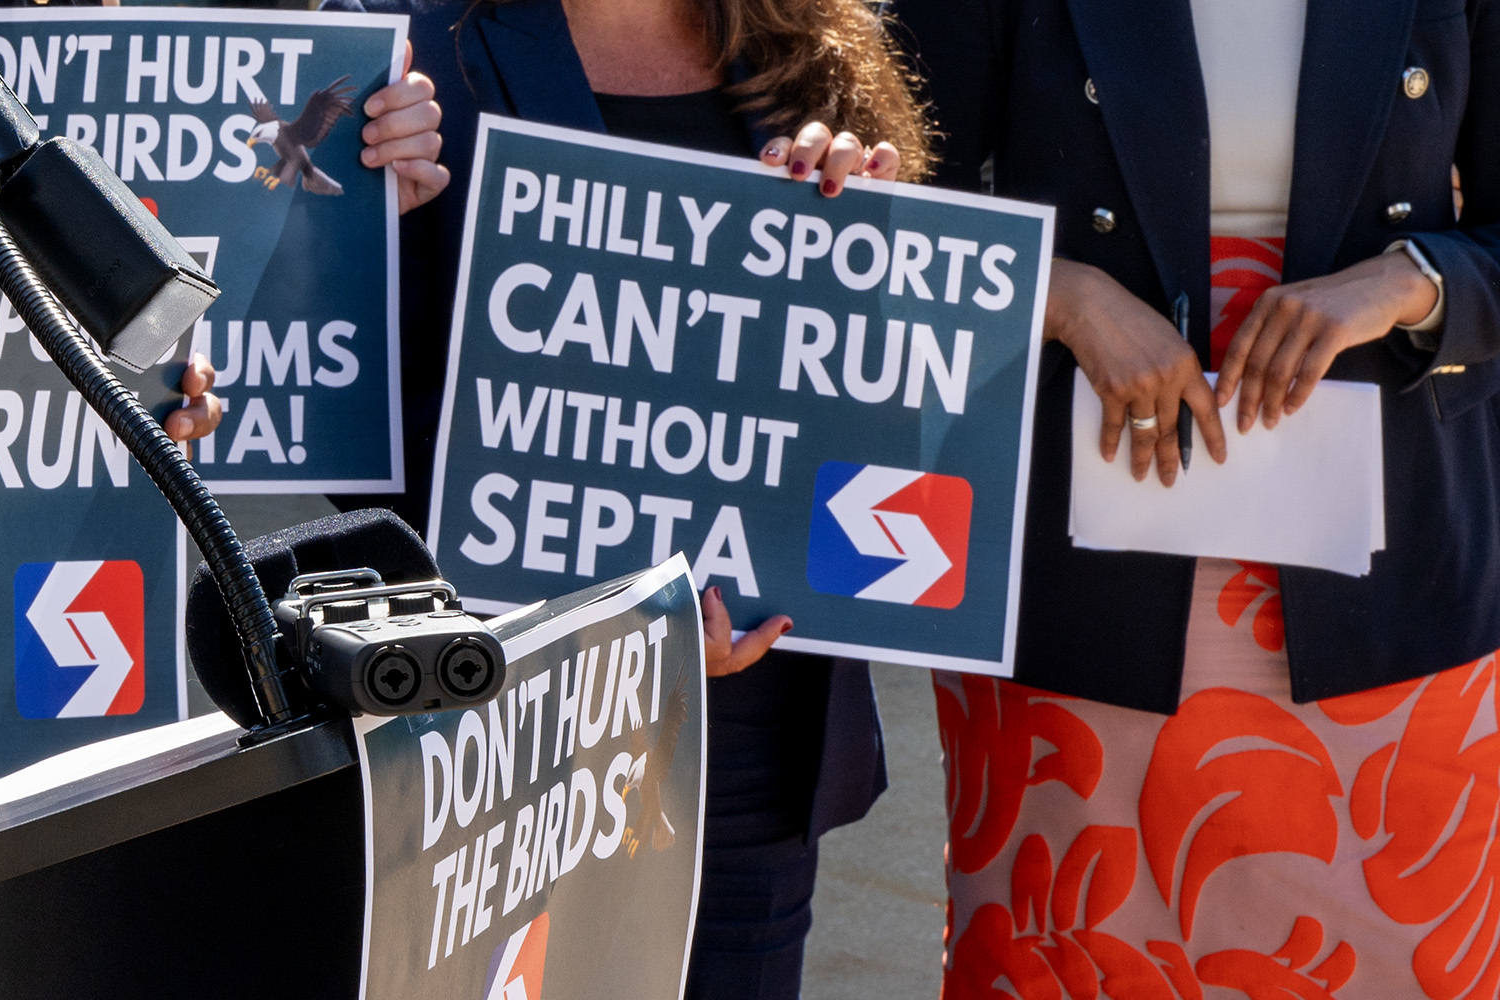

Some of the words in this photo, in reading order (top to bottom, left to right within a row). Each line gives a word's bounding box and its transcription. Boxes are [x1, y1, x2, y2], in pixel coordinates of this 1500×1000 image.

[125, 34, 313, 107] HURT
[498, 166, 731, 267] PHILLY
[740, 207, 1017, 311] SPORTS
[488, 262, 761, 383] CAN'T
[779, 305, 974, 416] RUN
[475, 377, 799, 487] WITHOUT
[459, 472, 761, 598] SEPTA
[419, 668, 551, 852] DON'T
[553, 614, 668, 769] HURT
[427, 820, 506, 971] THE
[502, 751, 636, 918] BIRDS
